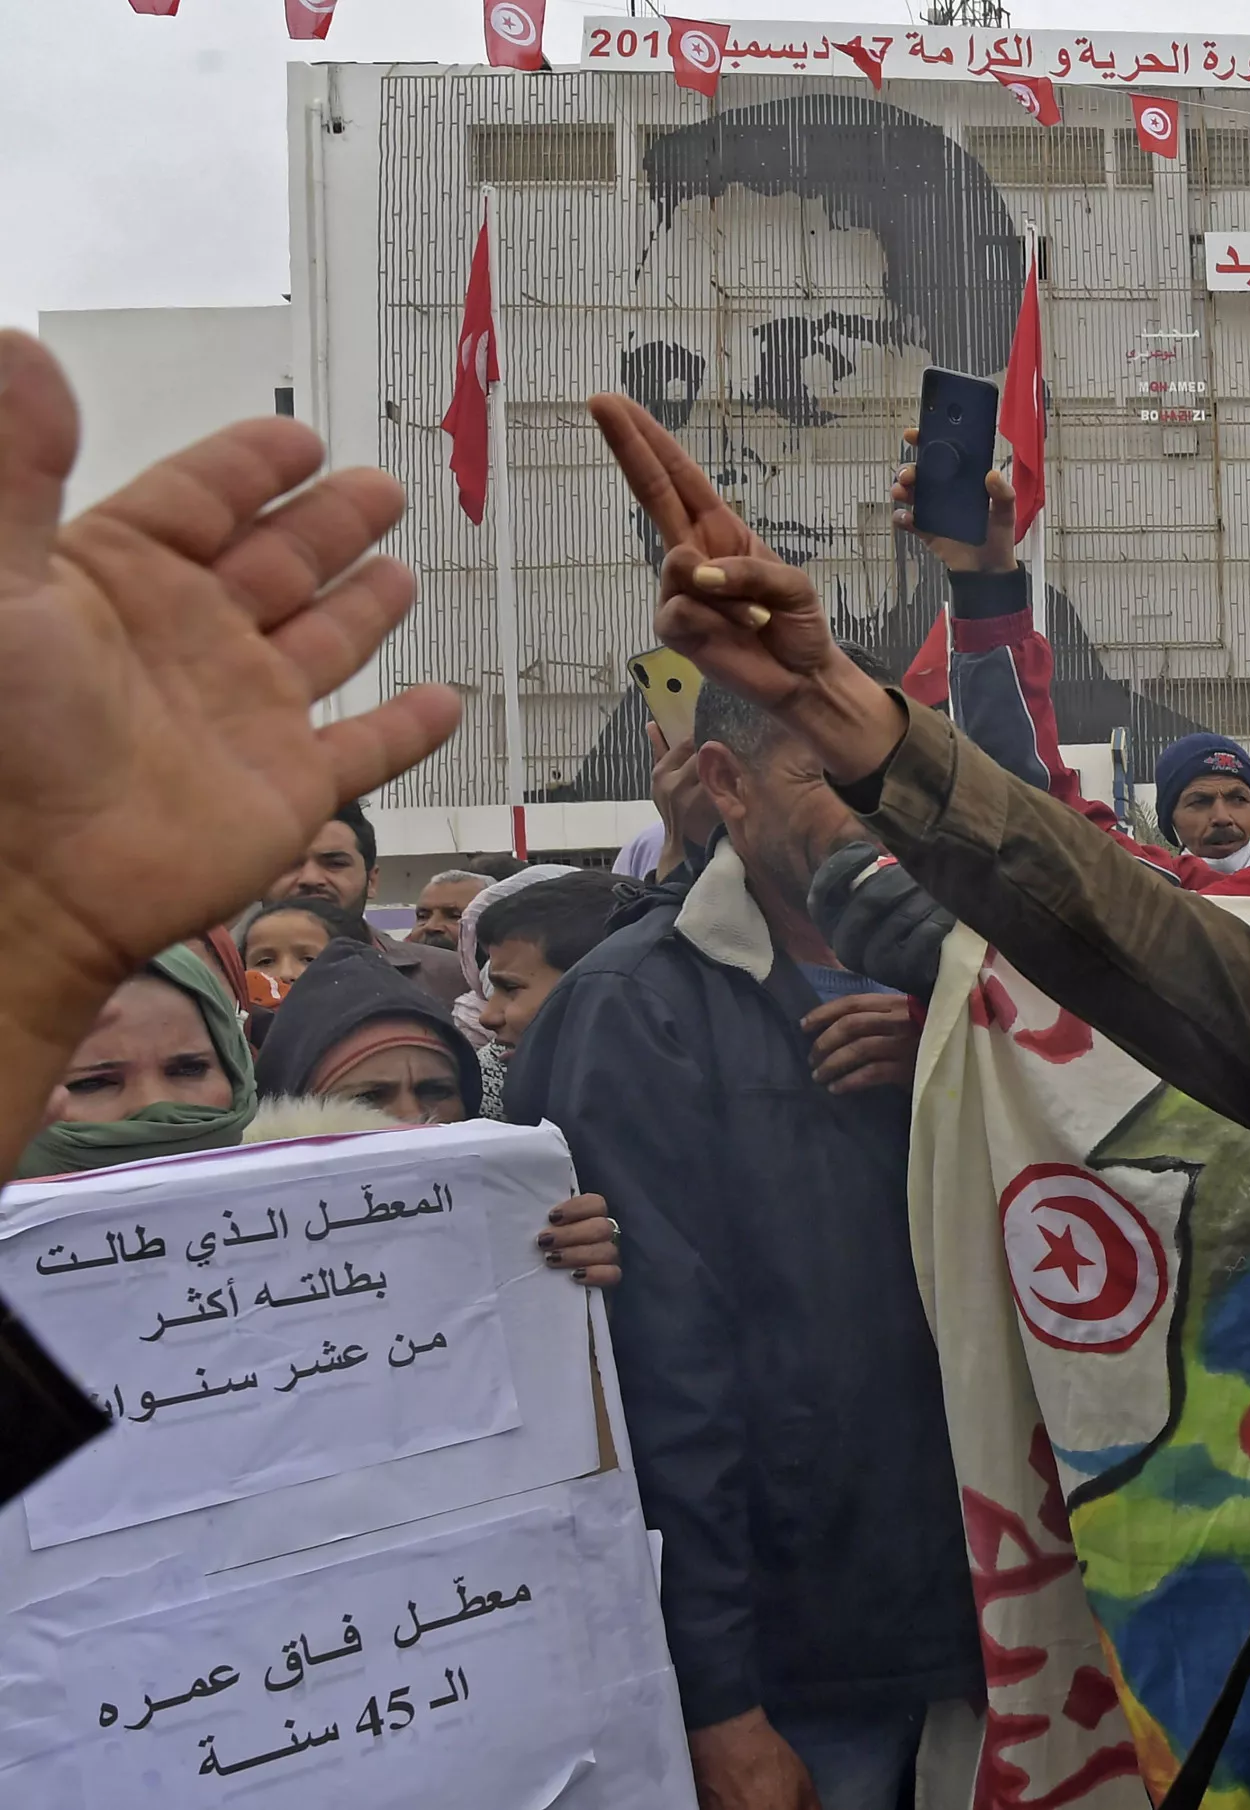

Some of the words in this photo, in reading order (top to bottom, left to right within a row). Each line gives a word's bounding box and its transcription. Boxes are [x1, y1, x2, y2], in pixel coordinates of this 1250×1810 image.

[721, 34, 830, 70] ديسمب
[1074, 36, 1190, 82] الحرية
[1138, 381, 1206, 393] MOHAMED
[1140, 408, 1207, 422] BOUAZIZI
[35, 1225, 167, 1276] طالت
[185, 1205, 289, 1267] الذي
[139, 1277, 240, 1342] أكثر
[253, 1260, 388, 1309] بطالته
[273, 1341, 369, 1393] عشر
[387, 1331, 448, 1369] من
[263, 1612, 364, 1691] فاق
[98, 1662, 242, 1730] عمره
[355, 1686, 416, 1738] 45
[197, 1718, 341, 1778] سنة
